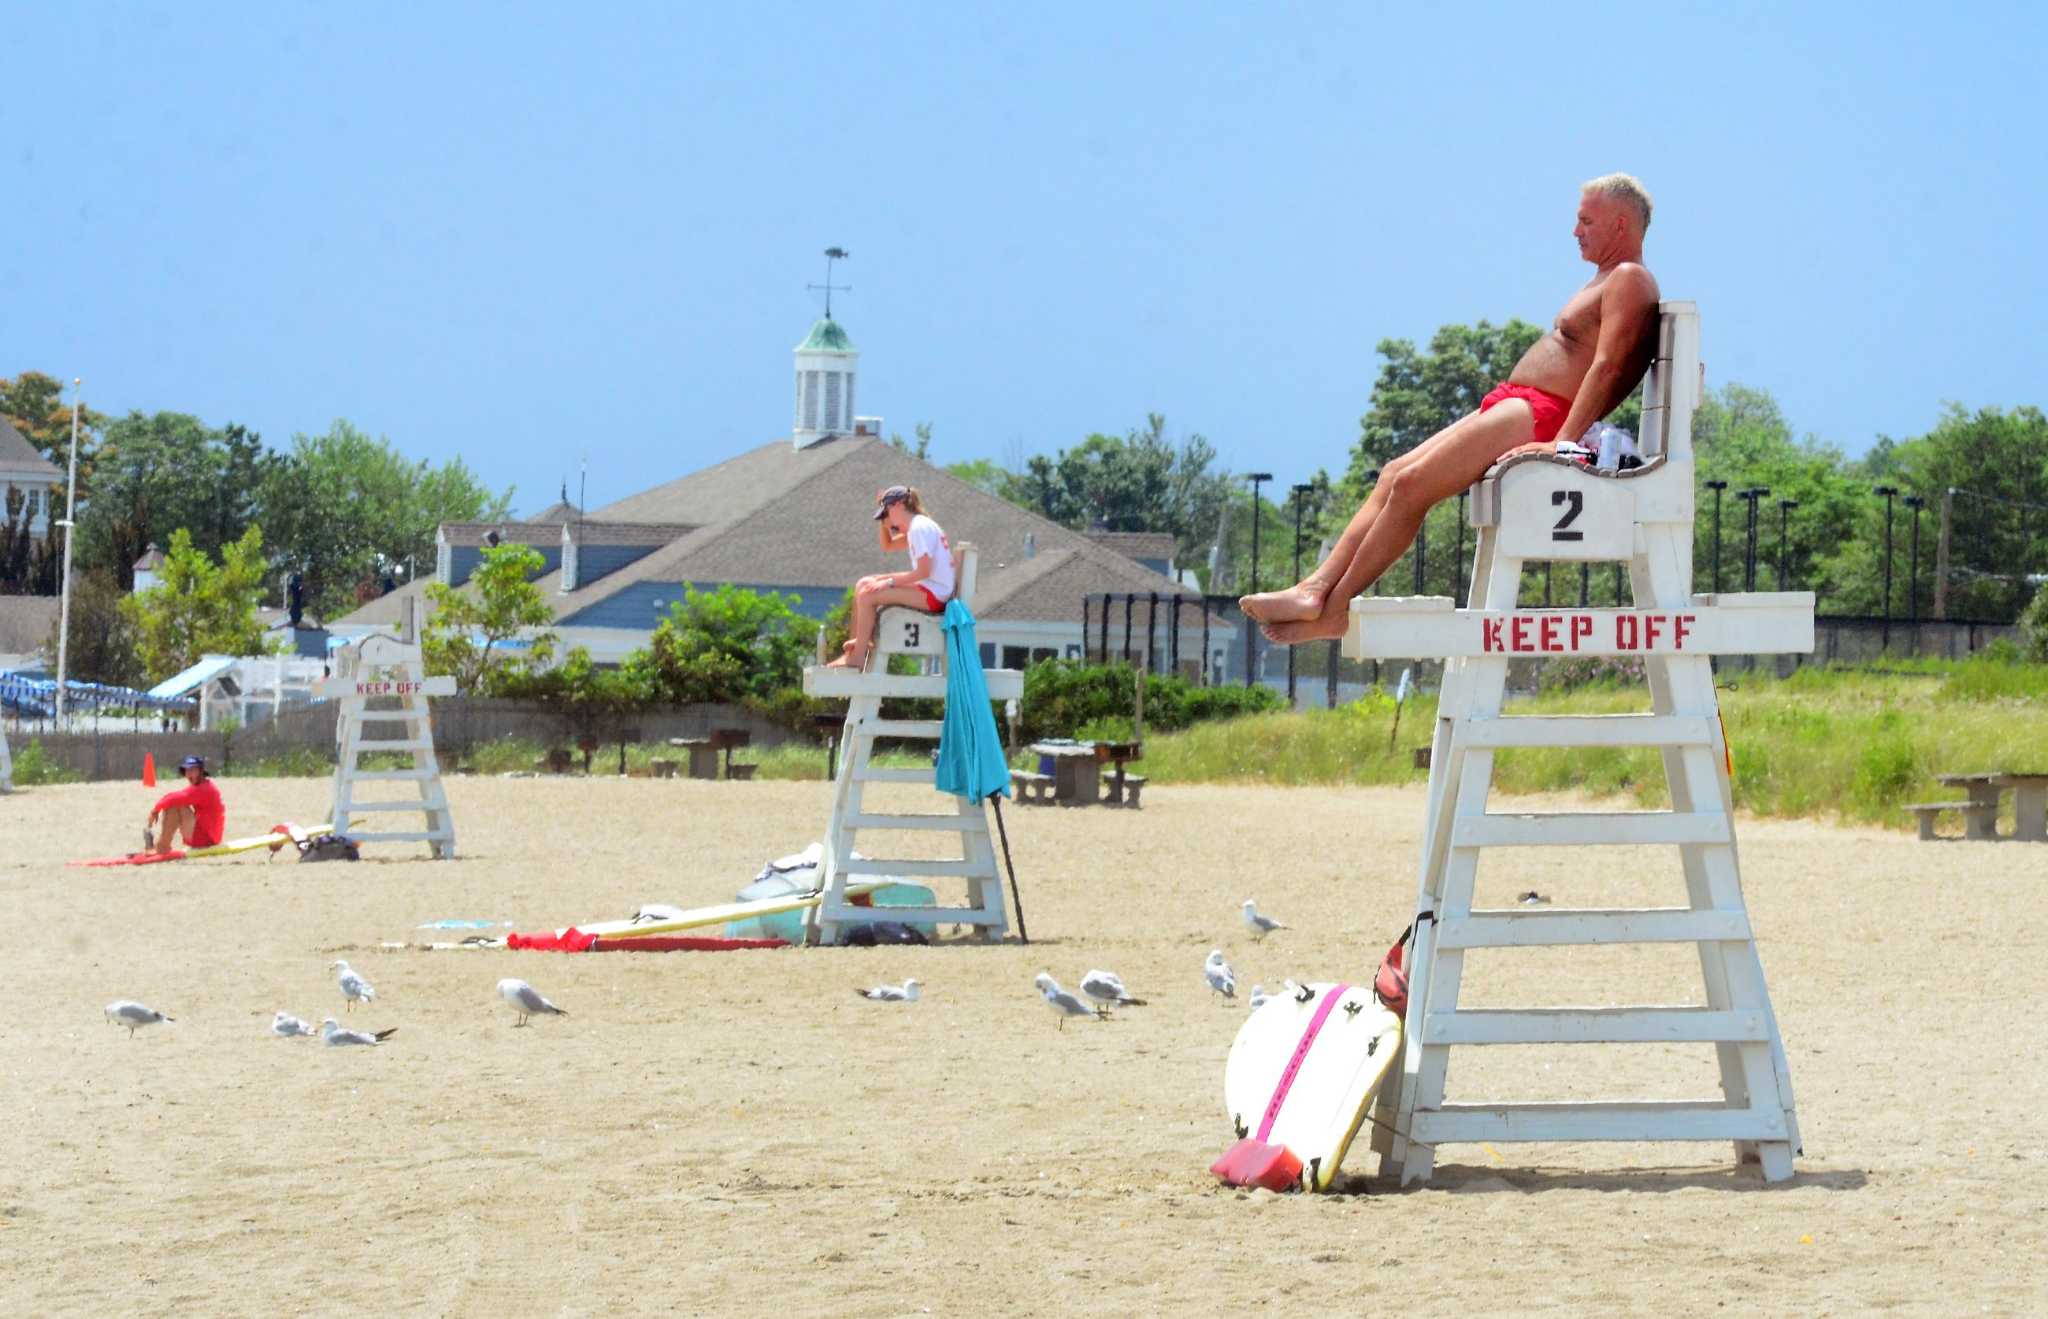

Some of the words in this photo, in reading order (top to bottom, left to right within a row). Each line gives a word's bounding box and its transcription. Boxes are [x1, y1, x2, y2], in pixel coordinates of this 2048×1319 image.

[1551, 491, 1584, 541] 2
[904, 623, 920, 648] 3
[1483, 616, 1593, 652] KEEP
[1616, 615, 1696, 650] OFF
[356, 682, 391, 695] KEEP
[396, 682, 422, 695] OFF
